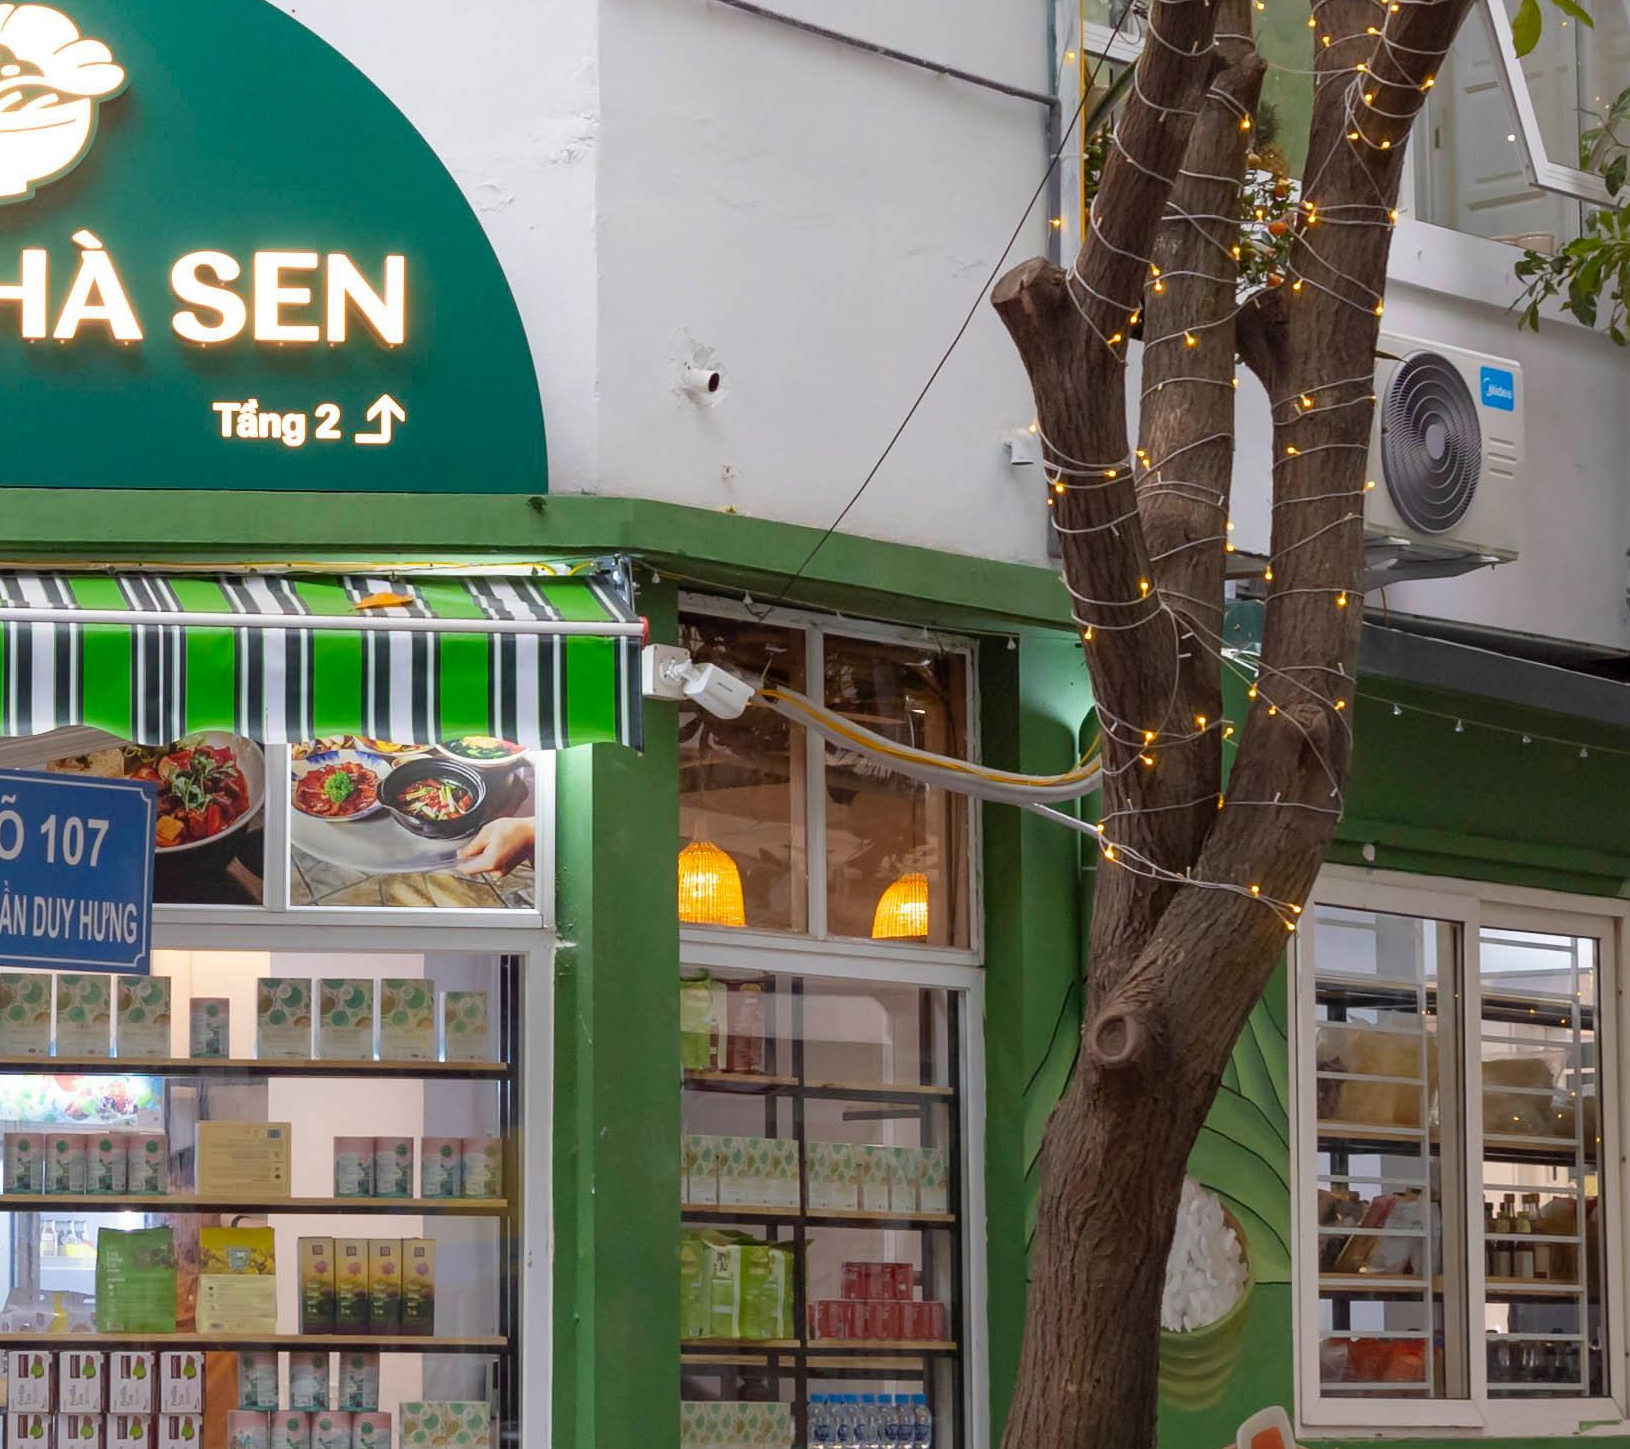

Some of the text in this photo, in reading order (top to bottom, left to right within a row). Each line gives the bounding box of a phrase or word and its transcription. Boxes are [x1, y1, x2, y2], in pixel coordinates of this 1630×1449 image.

[170, 250, 406, 345] SEN
[213, 400, 341, 447] Tầng 2
[40, 814, 110, 868] 107
[33, 896, 75, 940] DUY
[79, 900, 138, 945] HƯNG
